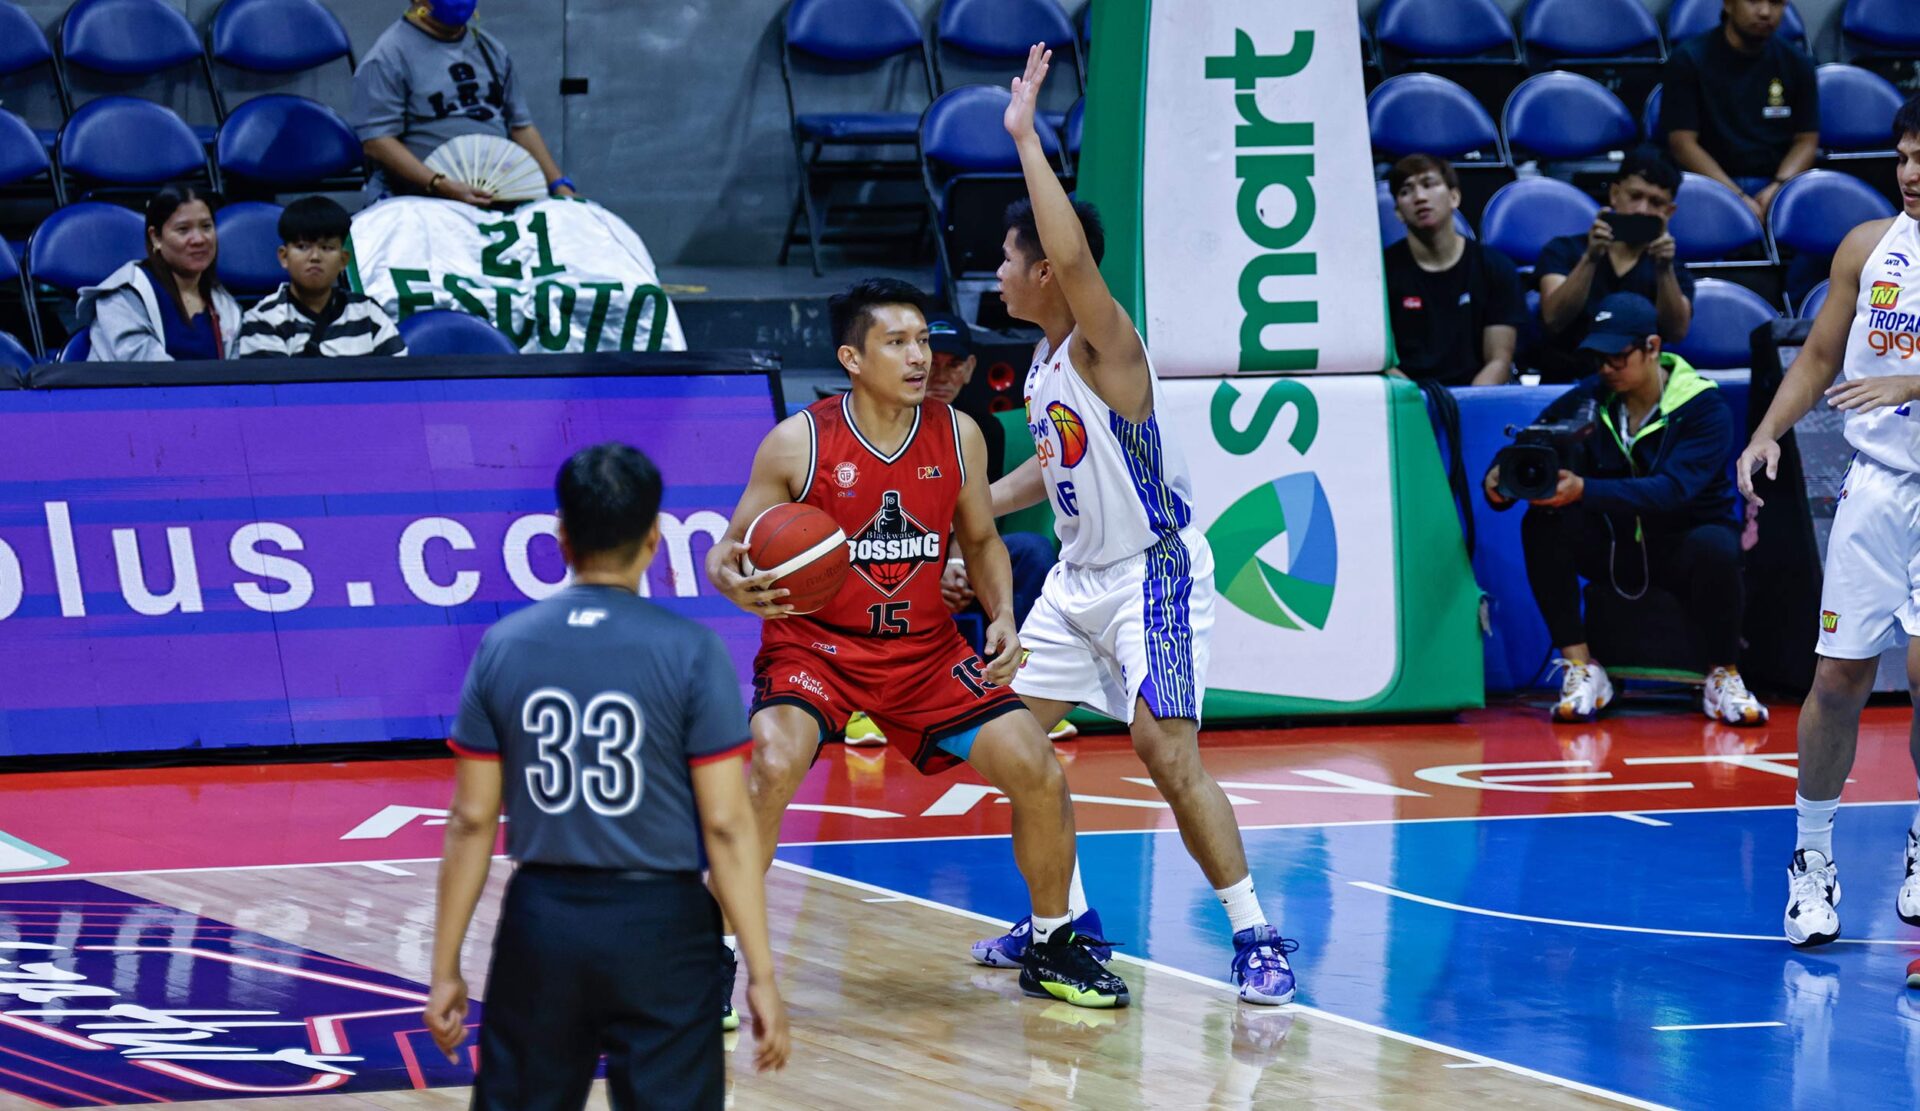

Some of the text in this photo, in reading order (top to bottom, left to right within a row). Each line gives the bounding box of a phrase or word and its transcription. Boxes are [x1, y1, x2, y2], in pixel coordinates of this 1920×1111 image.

[478, 211, 566, 280] 21
[1204, 27, 1320, 456] smart
[389, 268, 669, 352] ESCOTO
[1869, 286, 1905, 304] TNT
[1869, 309, 1920, 333] TROPA
[1868, 330, 1920, 360] gig
[918, 466, 942, 479] PBA
[847, 532, 940, 563] BOSSING
[866, 531, 915, 540] Blackwater
[0, 501, 730, 621] lus.com
[866, 600, 911, 637] 15
[788, 675, 830, 701] Organics
[800, 671, 823, 687] Ever
[952, 655, 999, 699] 15
[522, 687, 645, 817] 33
